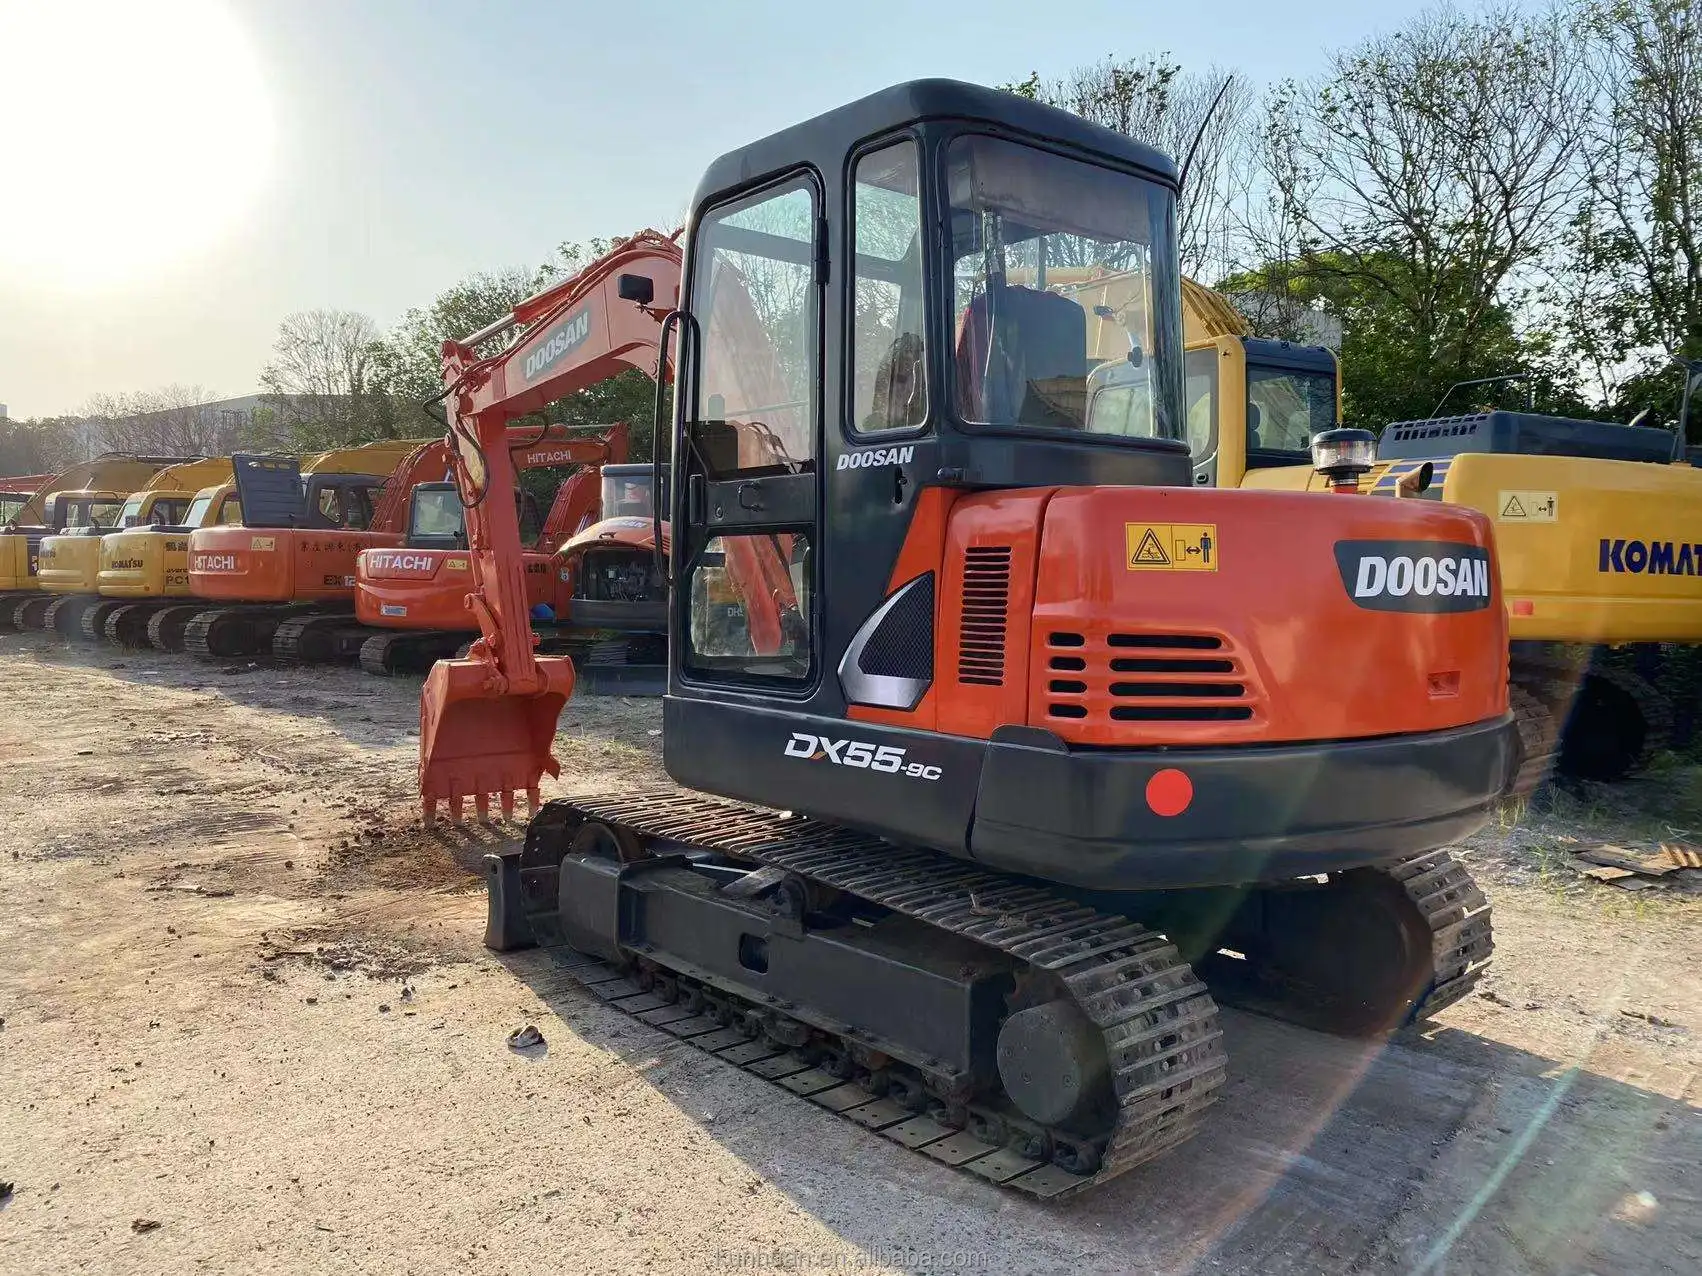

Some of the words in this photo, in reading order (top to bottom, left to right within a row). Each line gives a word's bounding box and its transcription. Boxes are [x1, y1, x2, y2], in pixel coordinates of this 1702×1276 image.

[525, 311, 588, 379] DOOSAN
[527, 450, 571, 464] HITACHI
[836, 445, 914, 471] DOOSAN
[194, 555, 234, 571] HITACHI
[369, 554, 432, 571] HITACHI
[1354, 556, 1488, 598] DOOSAN
[784, 732, 943, 781] DX55-9C
